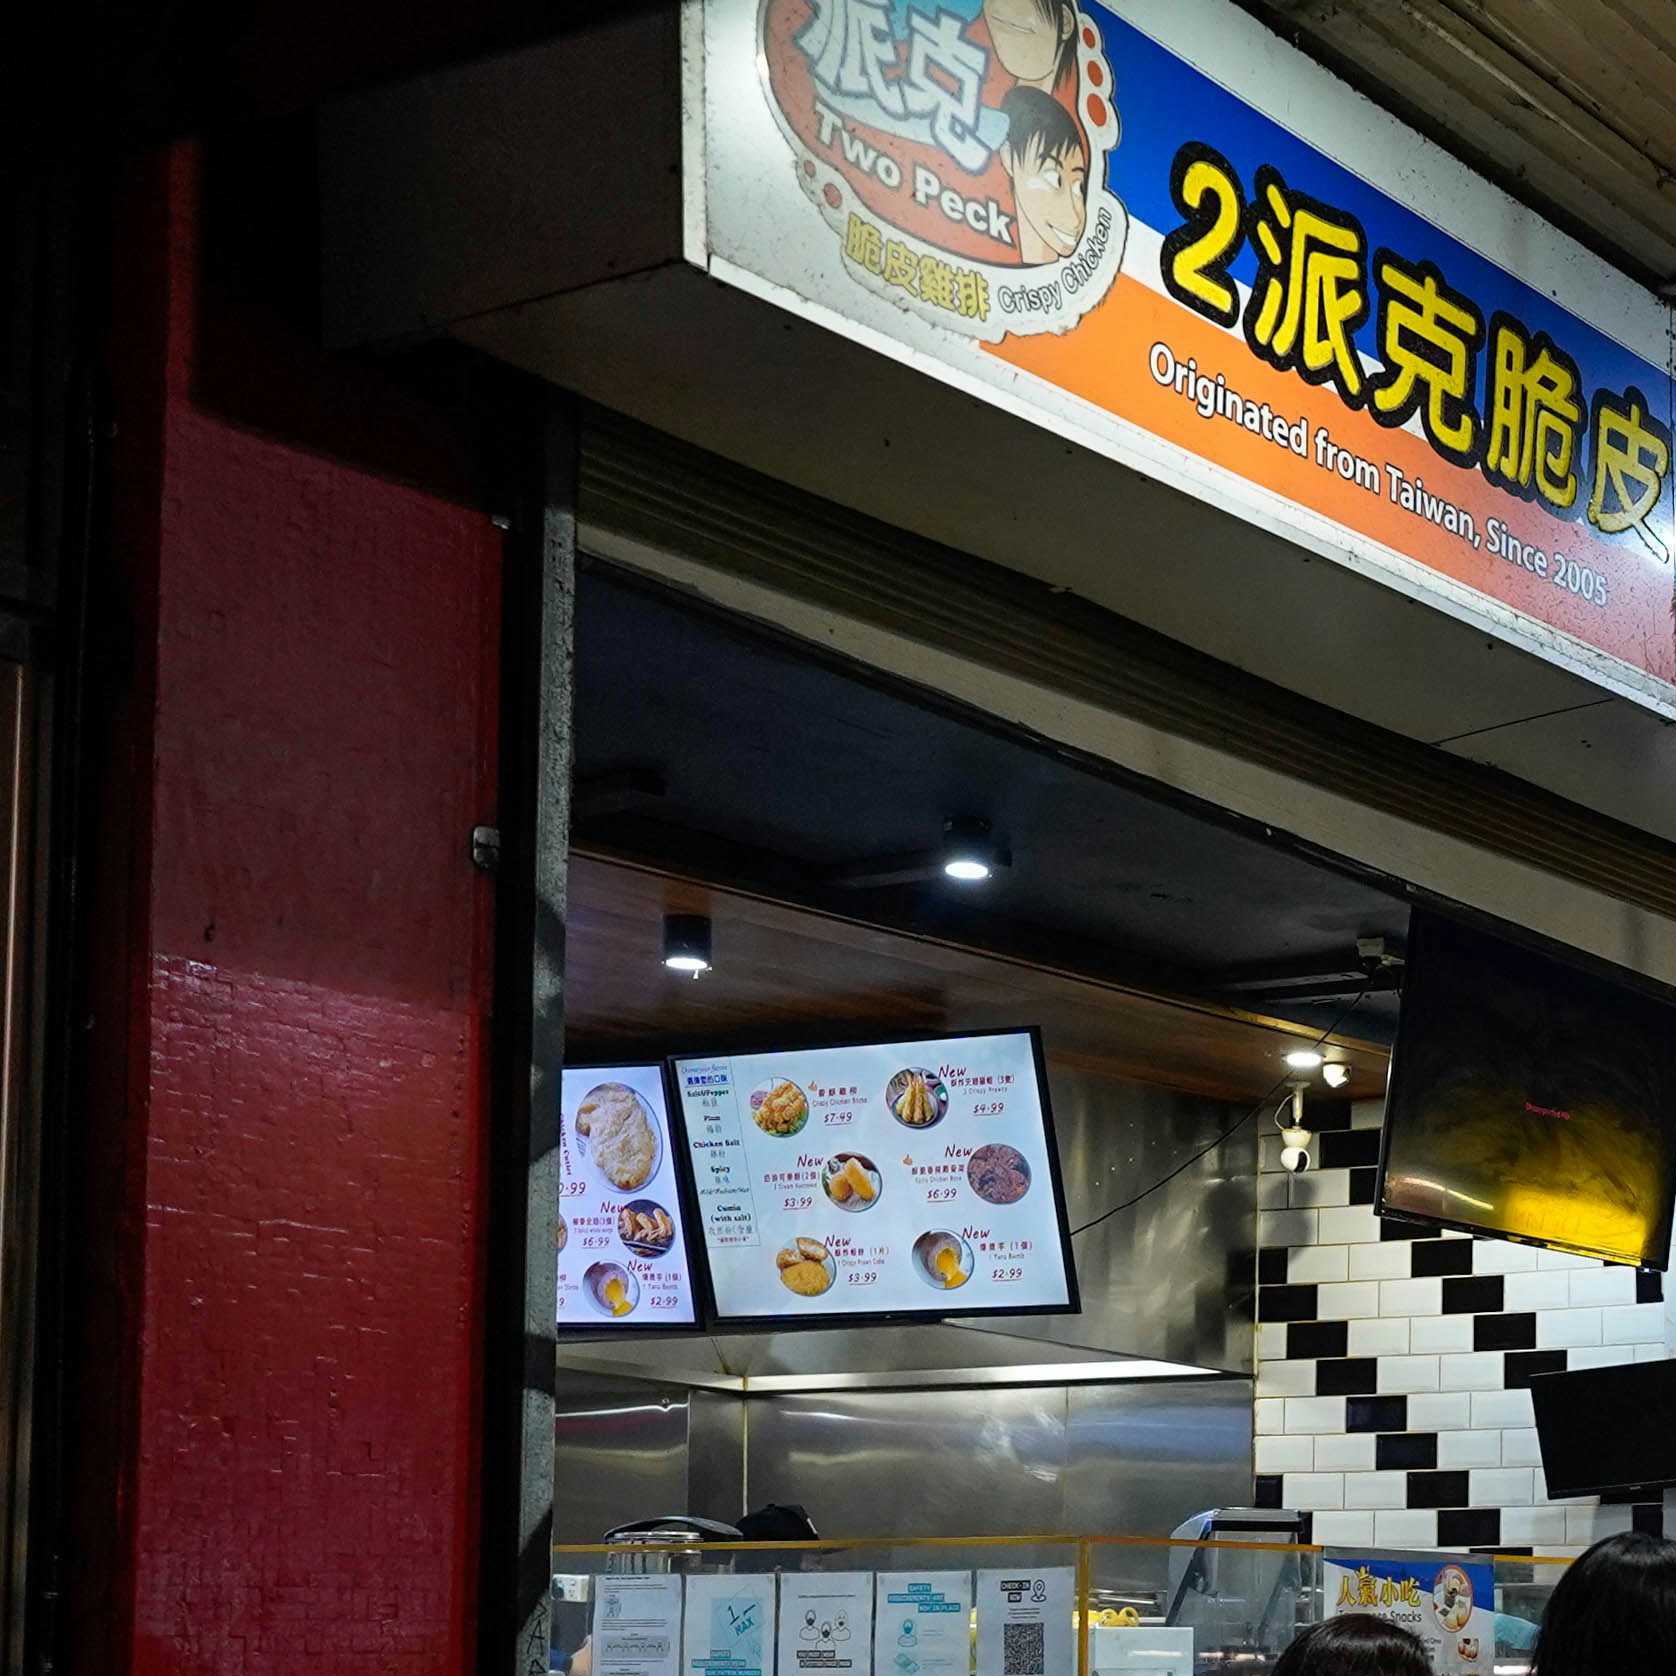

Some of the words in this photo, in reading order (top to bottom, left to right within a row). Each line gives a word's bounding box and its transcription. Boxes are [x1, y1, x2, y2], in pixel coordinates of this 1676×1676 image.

[813, 101, 903, 190] Two
[912, 168, 1015, 248] Peck
[844, 210, 991, 322] 脆皮雞排
[997, 279, 1064, 316] Crispy
[1060, 205, 1113, 296] Chicken
[1148, 343, 1309, 458] Originated
[1314, 427, 1380, 496] from
[1385, 463, 1482, 550] Taiwan,
[1485, 518, 1548, 580] Since
[1553, 552, 1609, 609] 2005
[939, 1064, 967, 1078] New
[945, 1144, 973, 1158] New
[797, 1153, 824, 1168] New
[962, 1226, 991, 1240] New
[824, 1234, 851, 1248] New
[627, 1260, 653, 1272] New
[1336, 1565, 1422, 1607] 人氣小吃
[1390, 1611, 1422, 1623] Snacks
